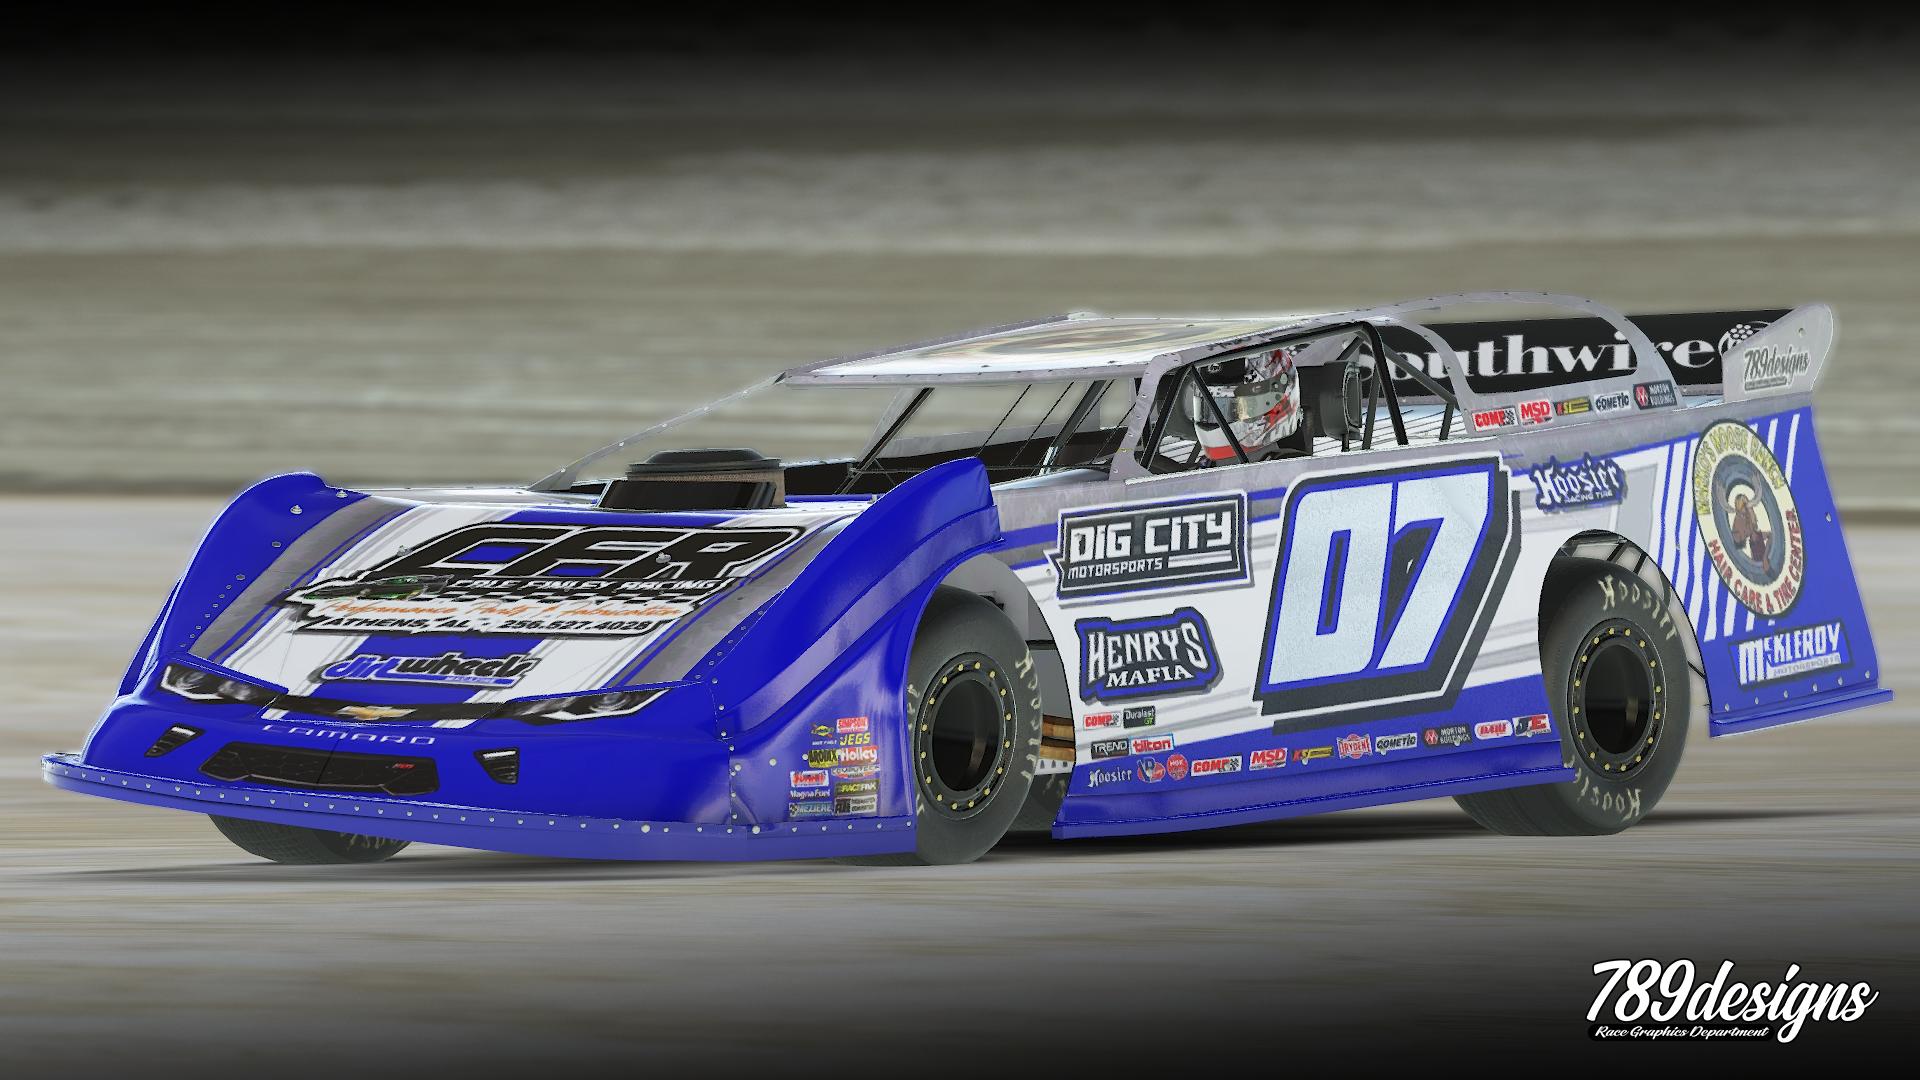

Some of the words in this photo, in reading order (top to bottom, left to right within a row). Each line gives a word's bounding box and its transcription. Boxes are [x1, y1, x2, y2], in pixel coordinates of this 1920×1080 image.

[1358, 330, 1715, 381] Southwie
[1520, 401, 1550, 418] MSD
[1534, 461, 1620, 506] Hoosier
[1070, 522, 1132, 563] DIG
[1145, 511, 1232, 554] CITY
[1068, 557, 1163, 579] MOTORSPORTS
[618, 579, 715, 589] RACING
[1266, 470, 1490, 686] 07
[1106, 664, 1194, 687] MAFIA
[1441, 726, 1466, 735] MORTON
[1516, 714, 1547, 735] JE
[262, 724, 437, 745] CAMARO
[840, 732, 871, 746] JEGS
[1376, 734, 1416, 749] COMETIC
[838, 747, 877, 763] Holley
[1093, 740, 1128, 756] TREND
[1251, 748, 1286, 764] MSD
[1193, 758, 1231, 774] COMP
[1088, 766, 1132, 788] Hoosier
